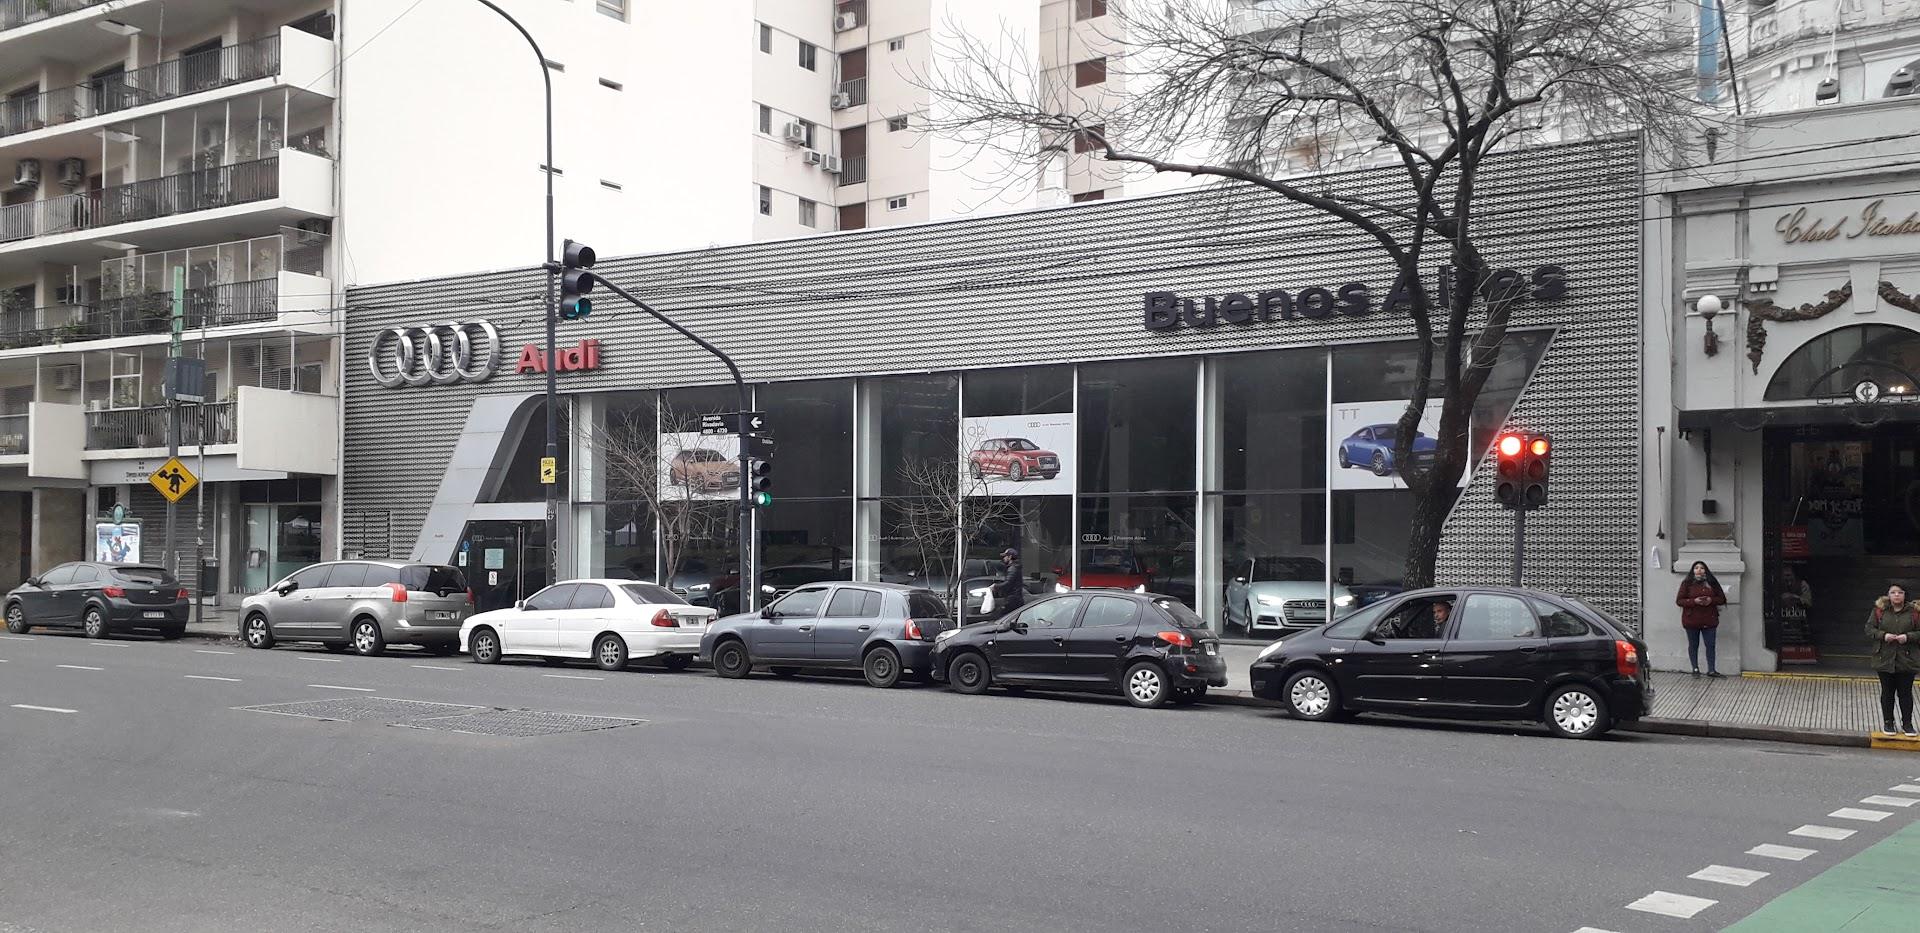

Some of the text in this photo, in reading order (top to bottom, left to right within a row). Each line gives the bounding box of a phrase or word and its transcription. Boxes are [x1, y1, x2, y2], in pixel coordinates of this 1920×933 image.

[1774, 206, 1849, 244] Club
[1143, 263, 1567, 333] Buenos Aies
[514, 338, 600, 375] Audi
